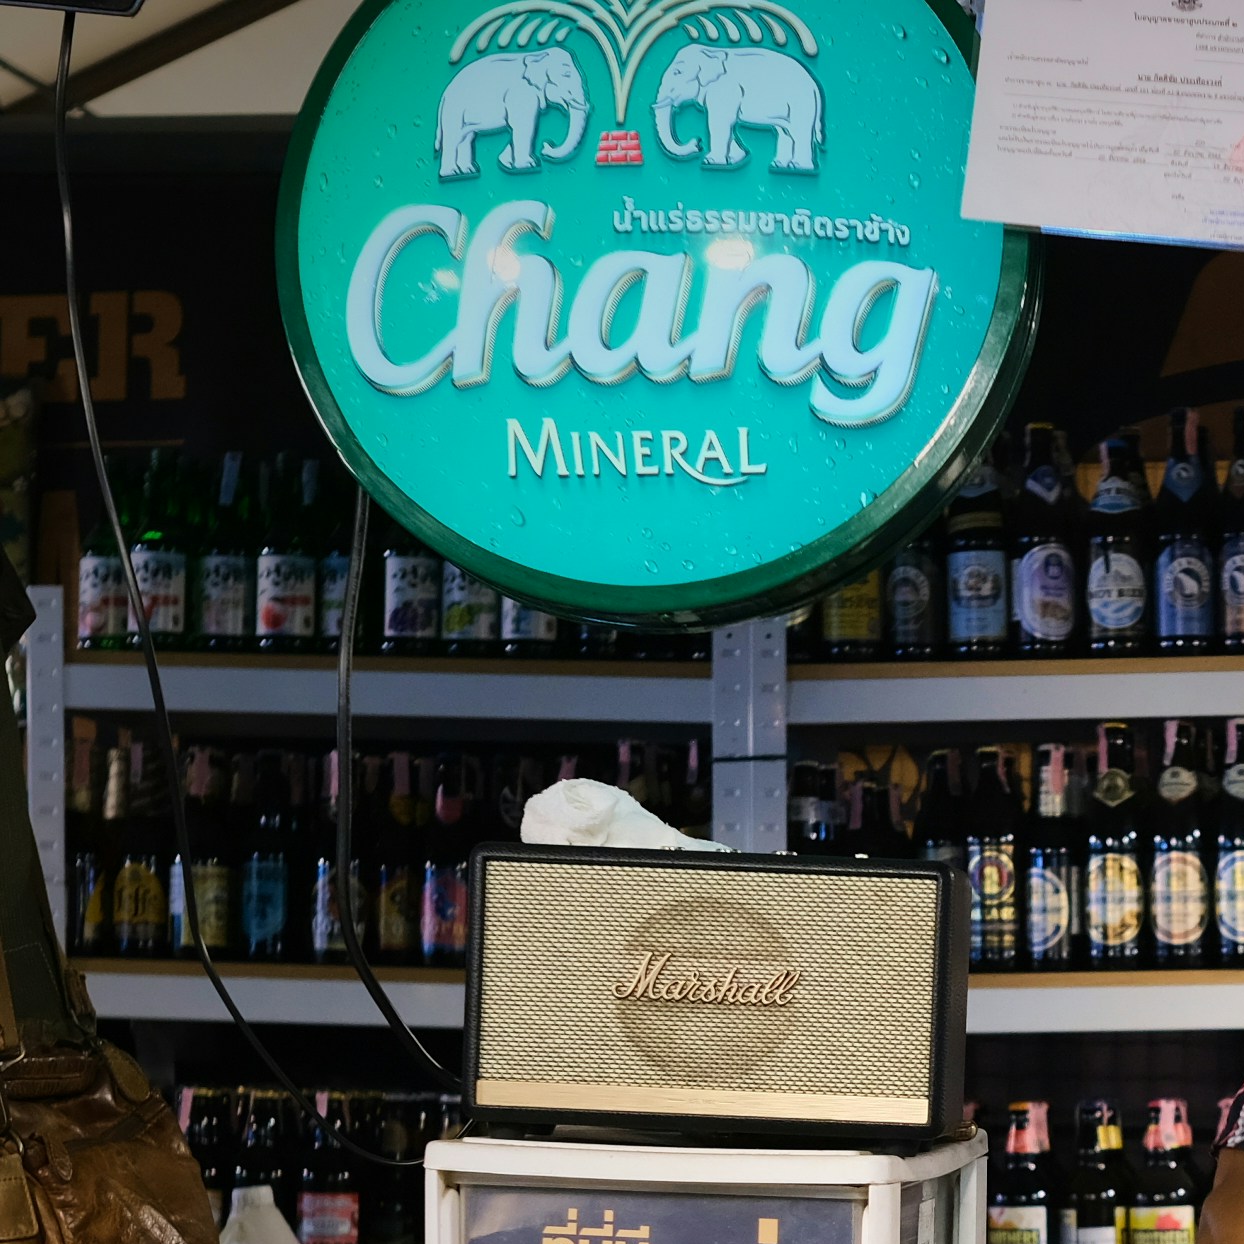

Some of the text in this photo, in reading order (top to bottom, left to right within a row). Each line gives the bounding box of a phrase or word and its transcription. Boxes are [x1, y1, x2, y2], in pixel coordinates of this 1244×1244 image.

[613, 195, 911, 247] น้ำแร่ธรรมชาติตราช้าง
[345, 199, 940, 430] Chang
[506, 417, 768, 487] MINERAL
[612, 950, 803, 1008] Marshall
